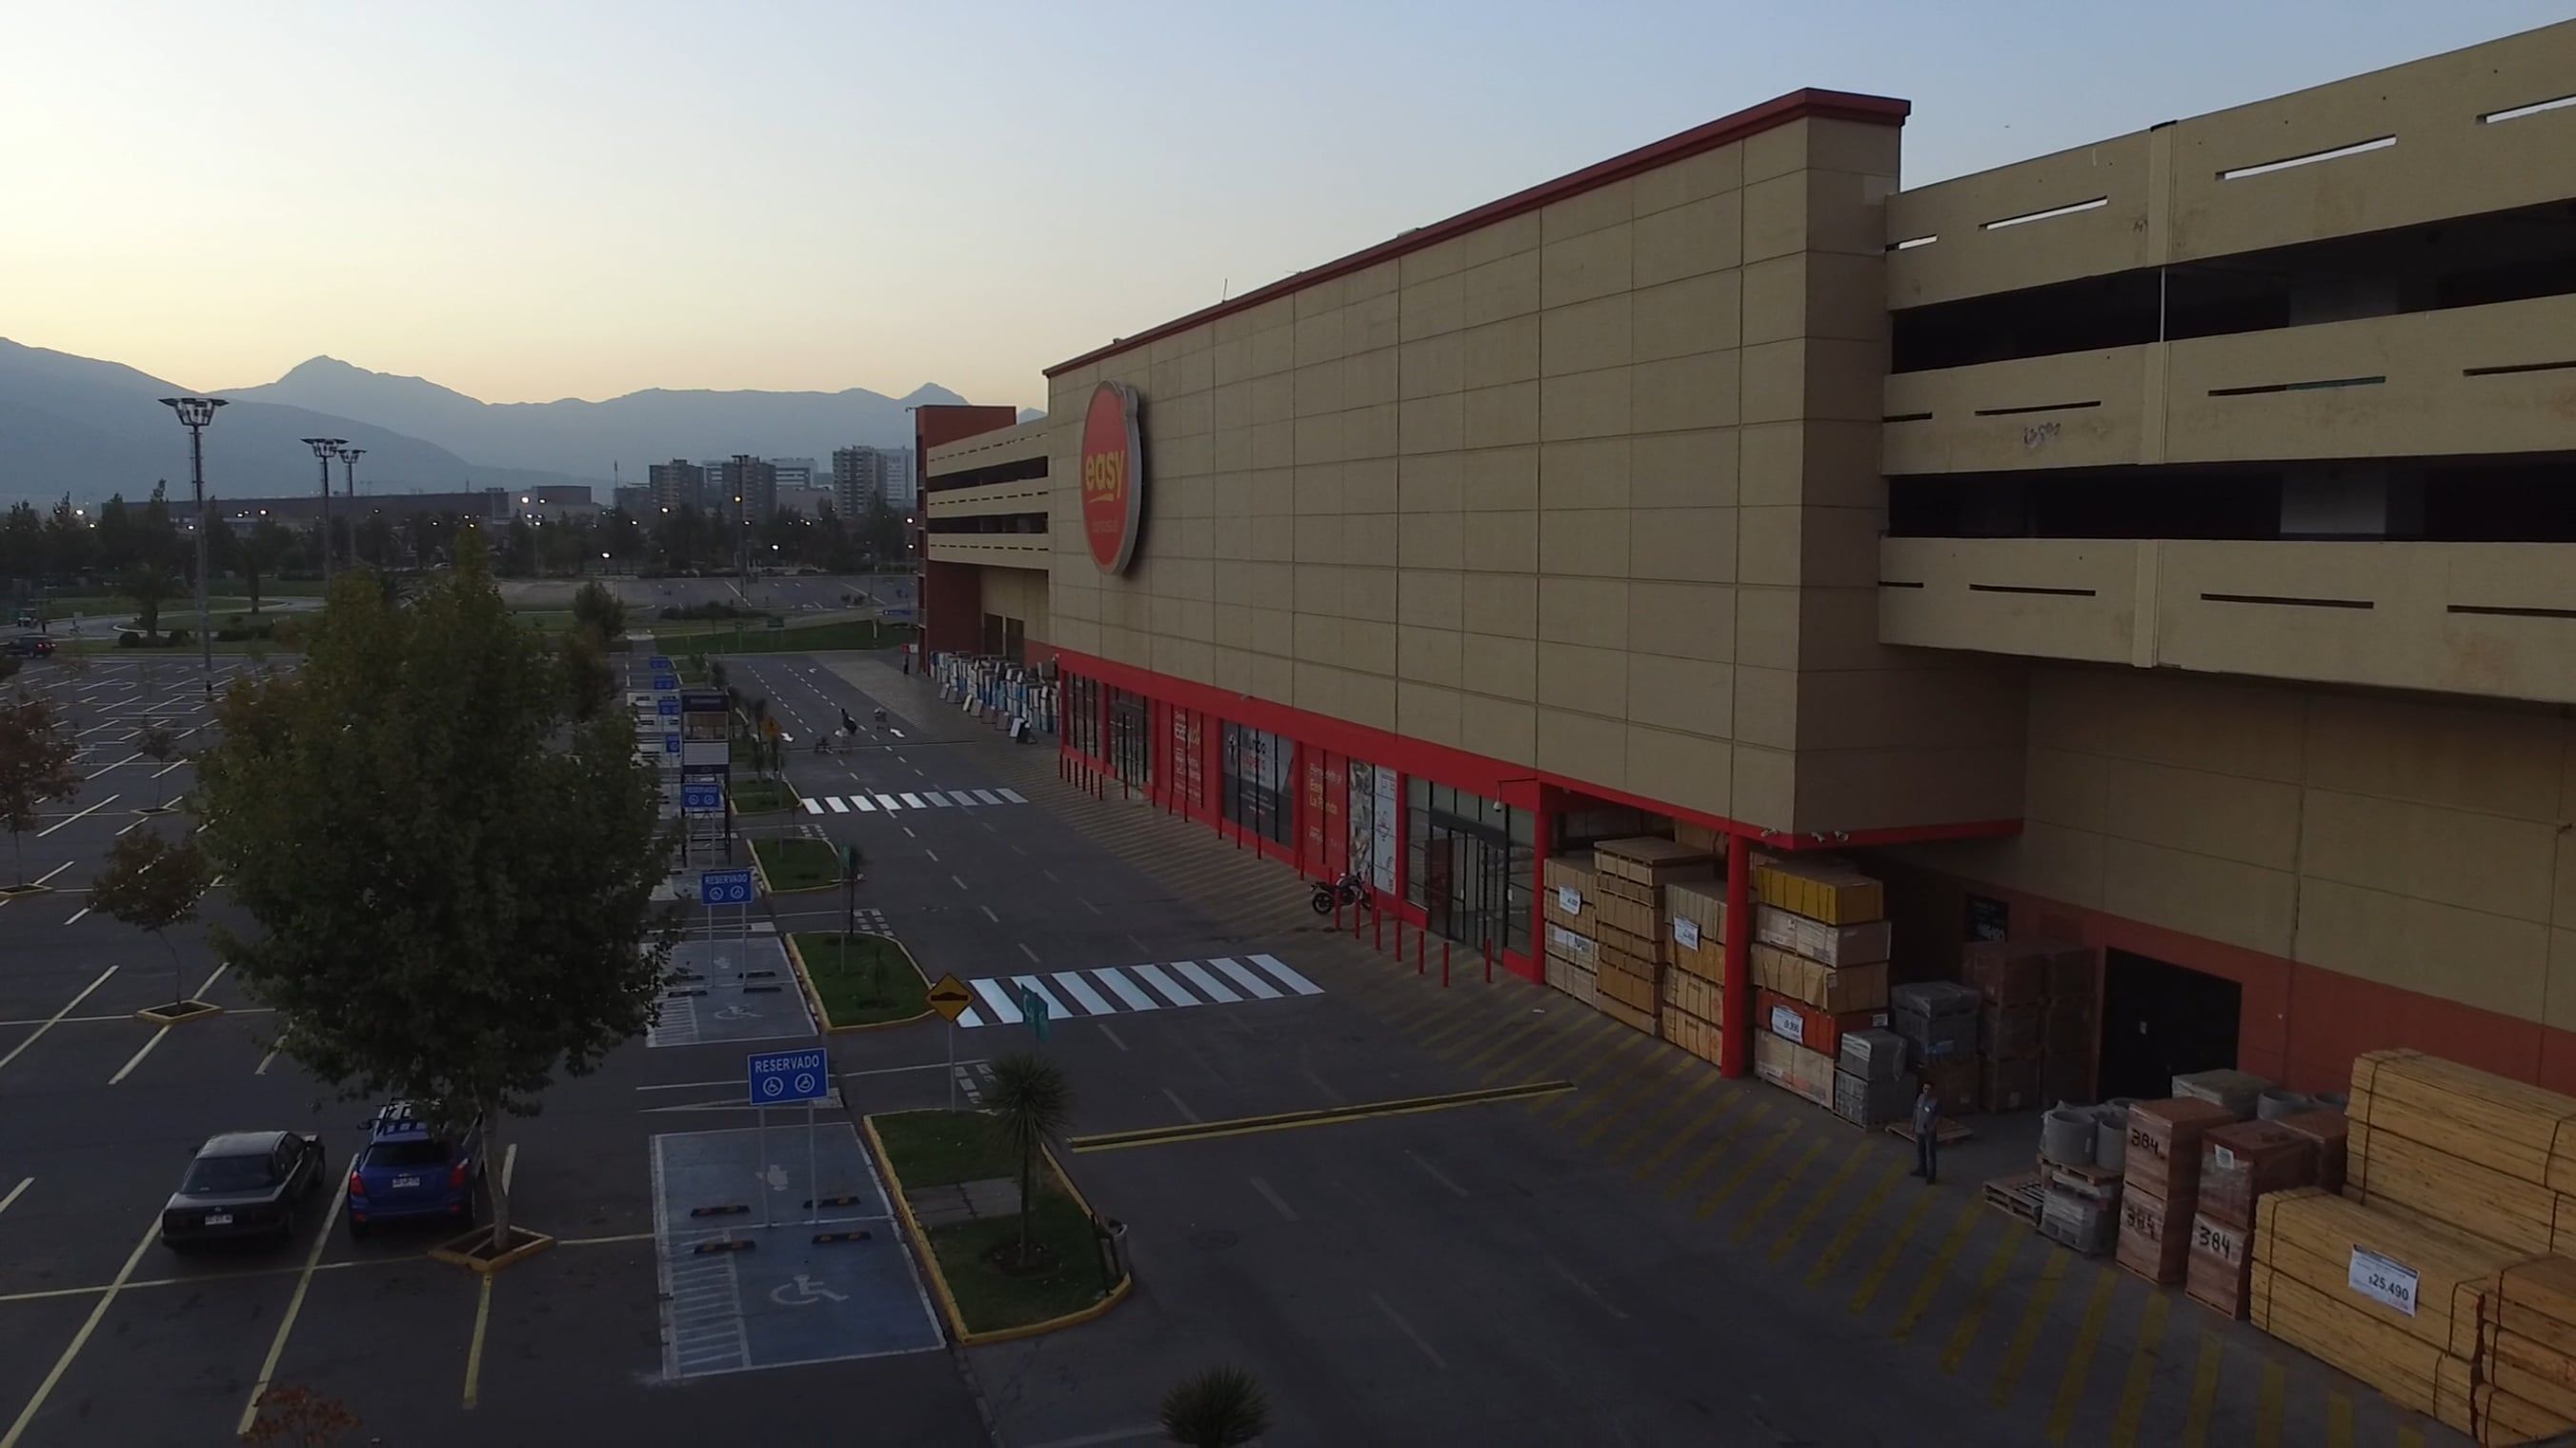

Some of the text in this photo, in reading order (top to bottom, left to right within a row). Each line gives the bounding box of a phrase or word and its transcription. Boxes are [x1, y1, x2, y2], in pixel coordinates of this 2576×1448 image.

[1085, 450, 1125, 500] easy
[705, 873, 749, 885] RESERVADO
[755, 1055, 820, 1073] RESERVADO
[2199, 1226, 2230, 1258] 384
